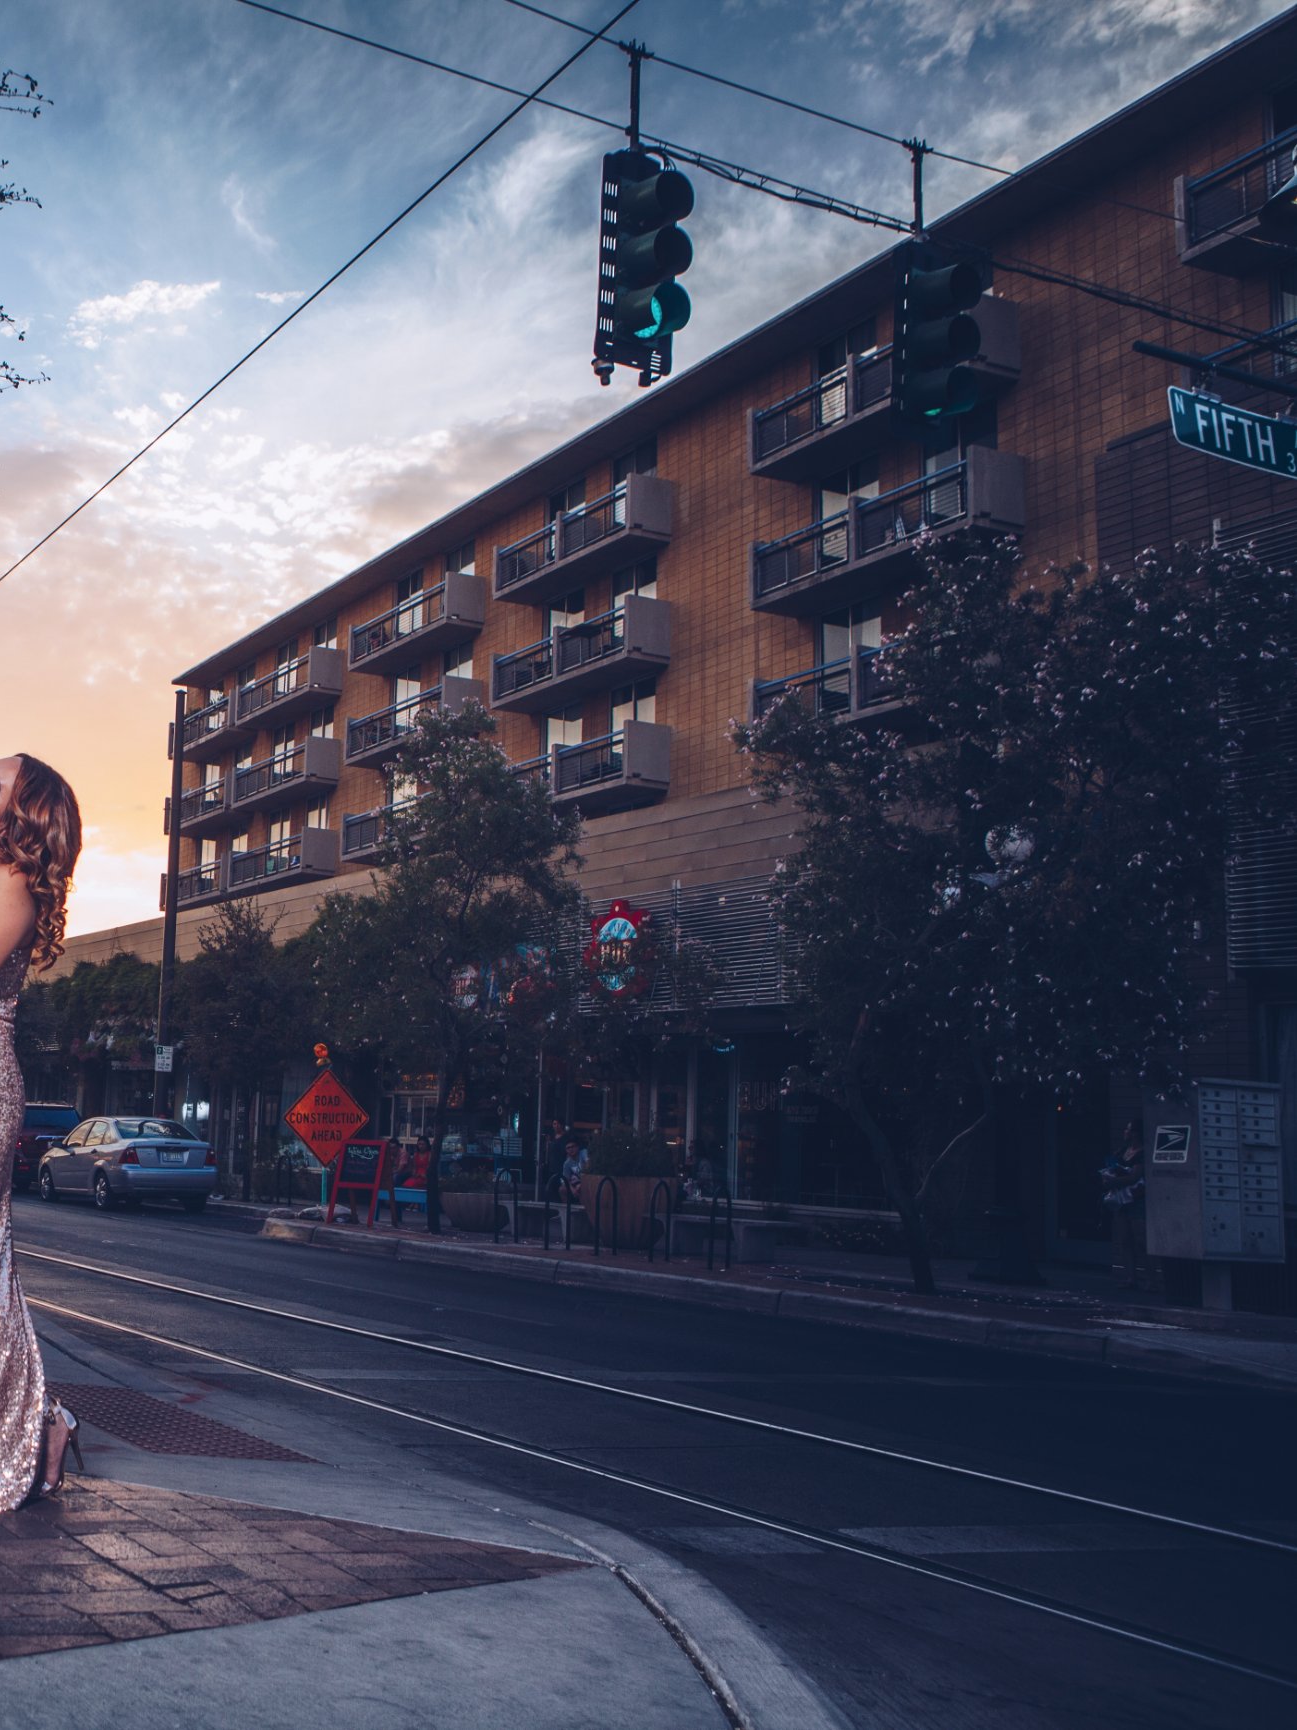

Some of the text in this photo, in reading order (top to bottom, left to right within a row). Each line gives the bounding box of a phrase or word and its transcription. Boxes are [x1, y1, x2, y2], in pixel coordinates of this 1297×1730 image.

[1174, 392, 1277, 465] N FIFTH
[314, 1095, 340, 1106] ROAD
[289, 1112, 363, 1124] CONSTRUCTION
[311, 1130, 342, 1141] AHEAD
